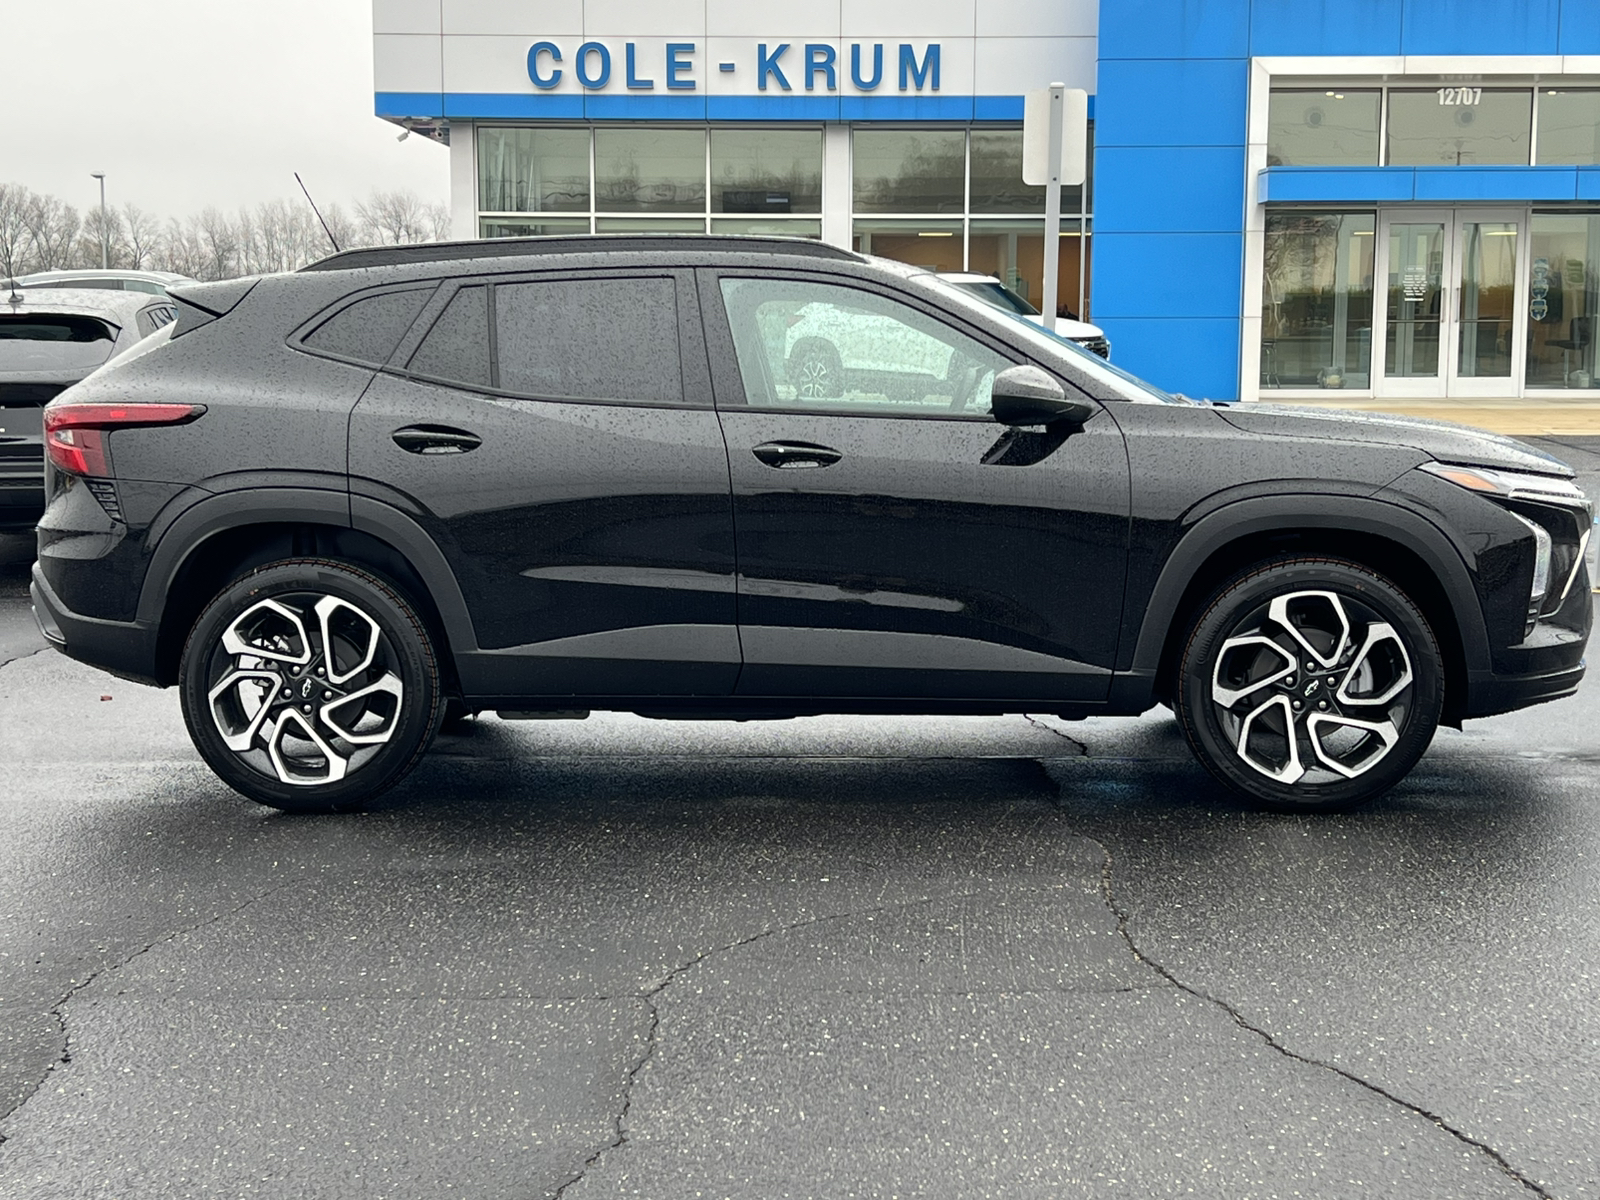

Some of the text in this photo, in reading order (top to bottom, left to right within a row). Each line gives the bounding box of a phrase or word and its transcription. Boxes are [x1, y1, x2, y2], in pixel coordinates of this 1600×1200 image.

[527, 41, 696, 91] COLE
[757, 43, 942, 92] KRUM
[1436, 87, 1482, 106] 12707
